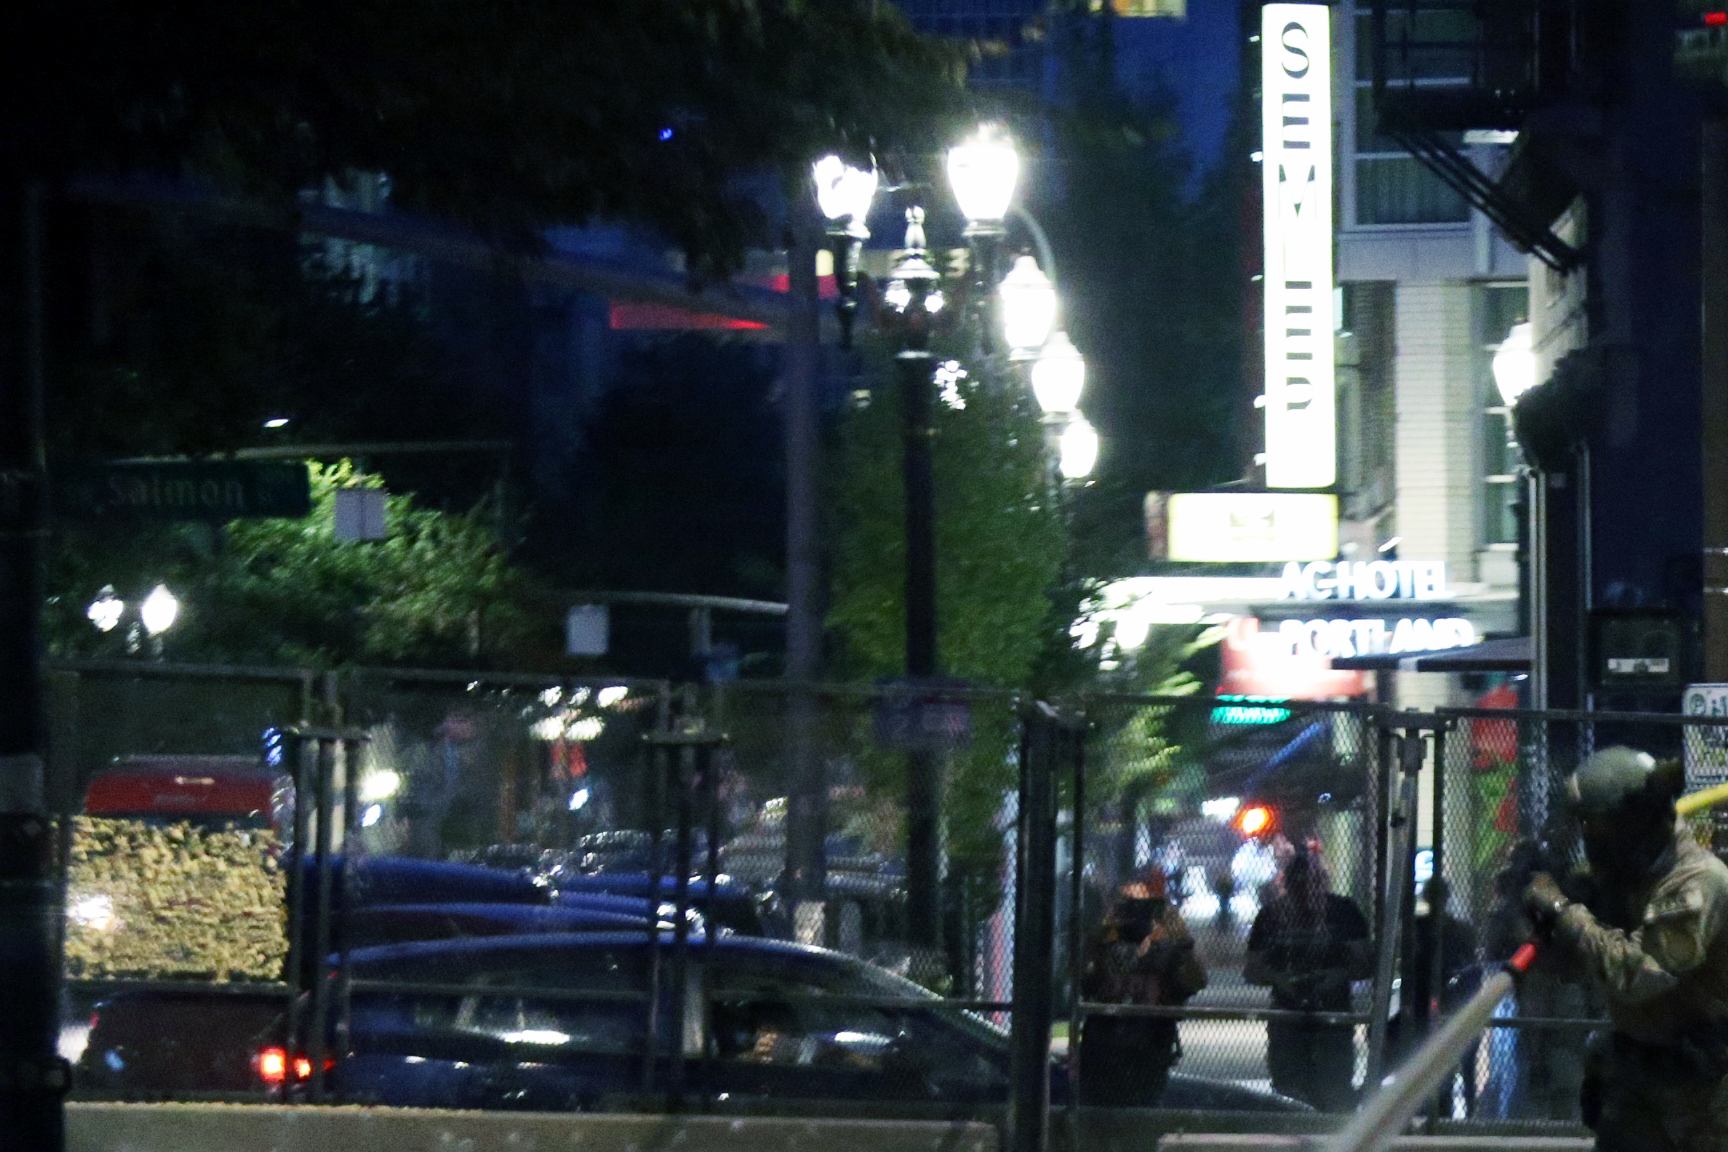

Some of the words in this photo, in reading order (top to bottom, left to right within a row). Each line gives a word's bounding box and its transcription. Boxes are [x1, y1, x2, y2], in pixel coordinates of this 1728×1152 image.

[106, 472, 246, 508] Salmon
[1279, 559, 1333, 600] AC
[1336, 559, 1453, 600] HOTEL
[1279, 617, 1477, 658] PORTLAND
